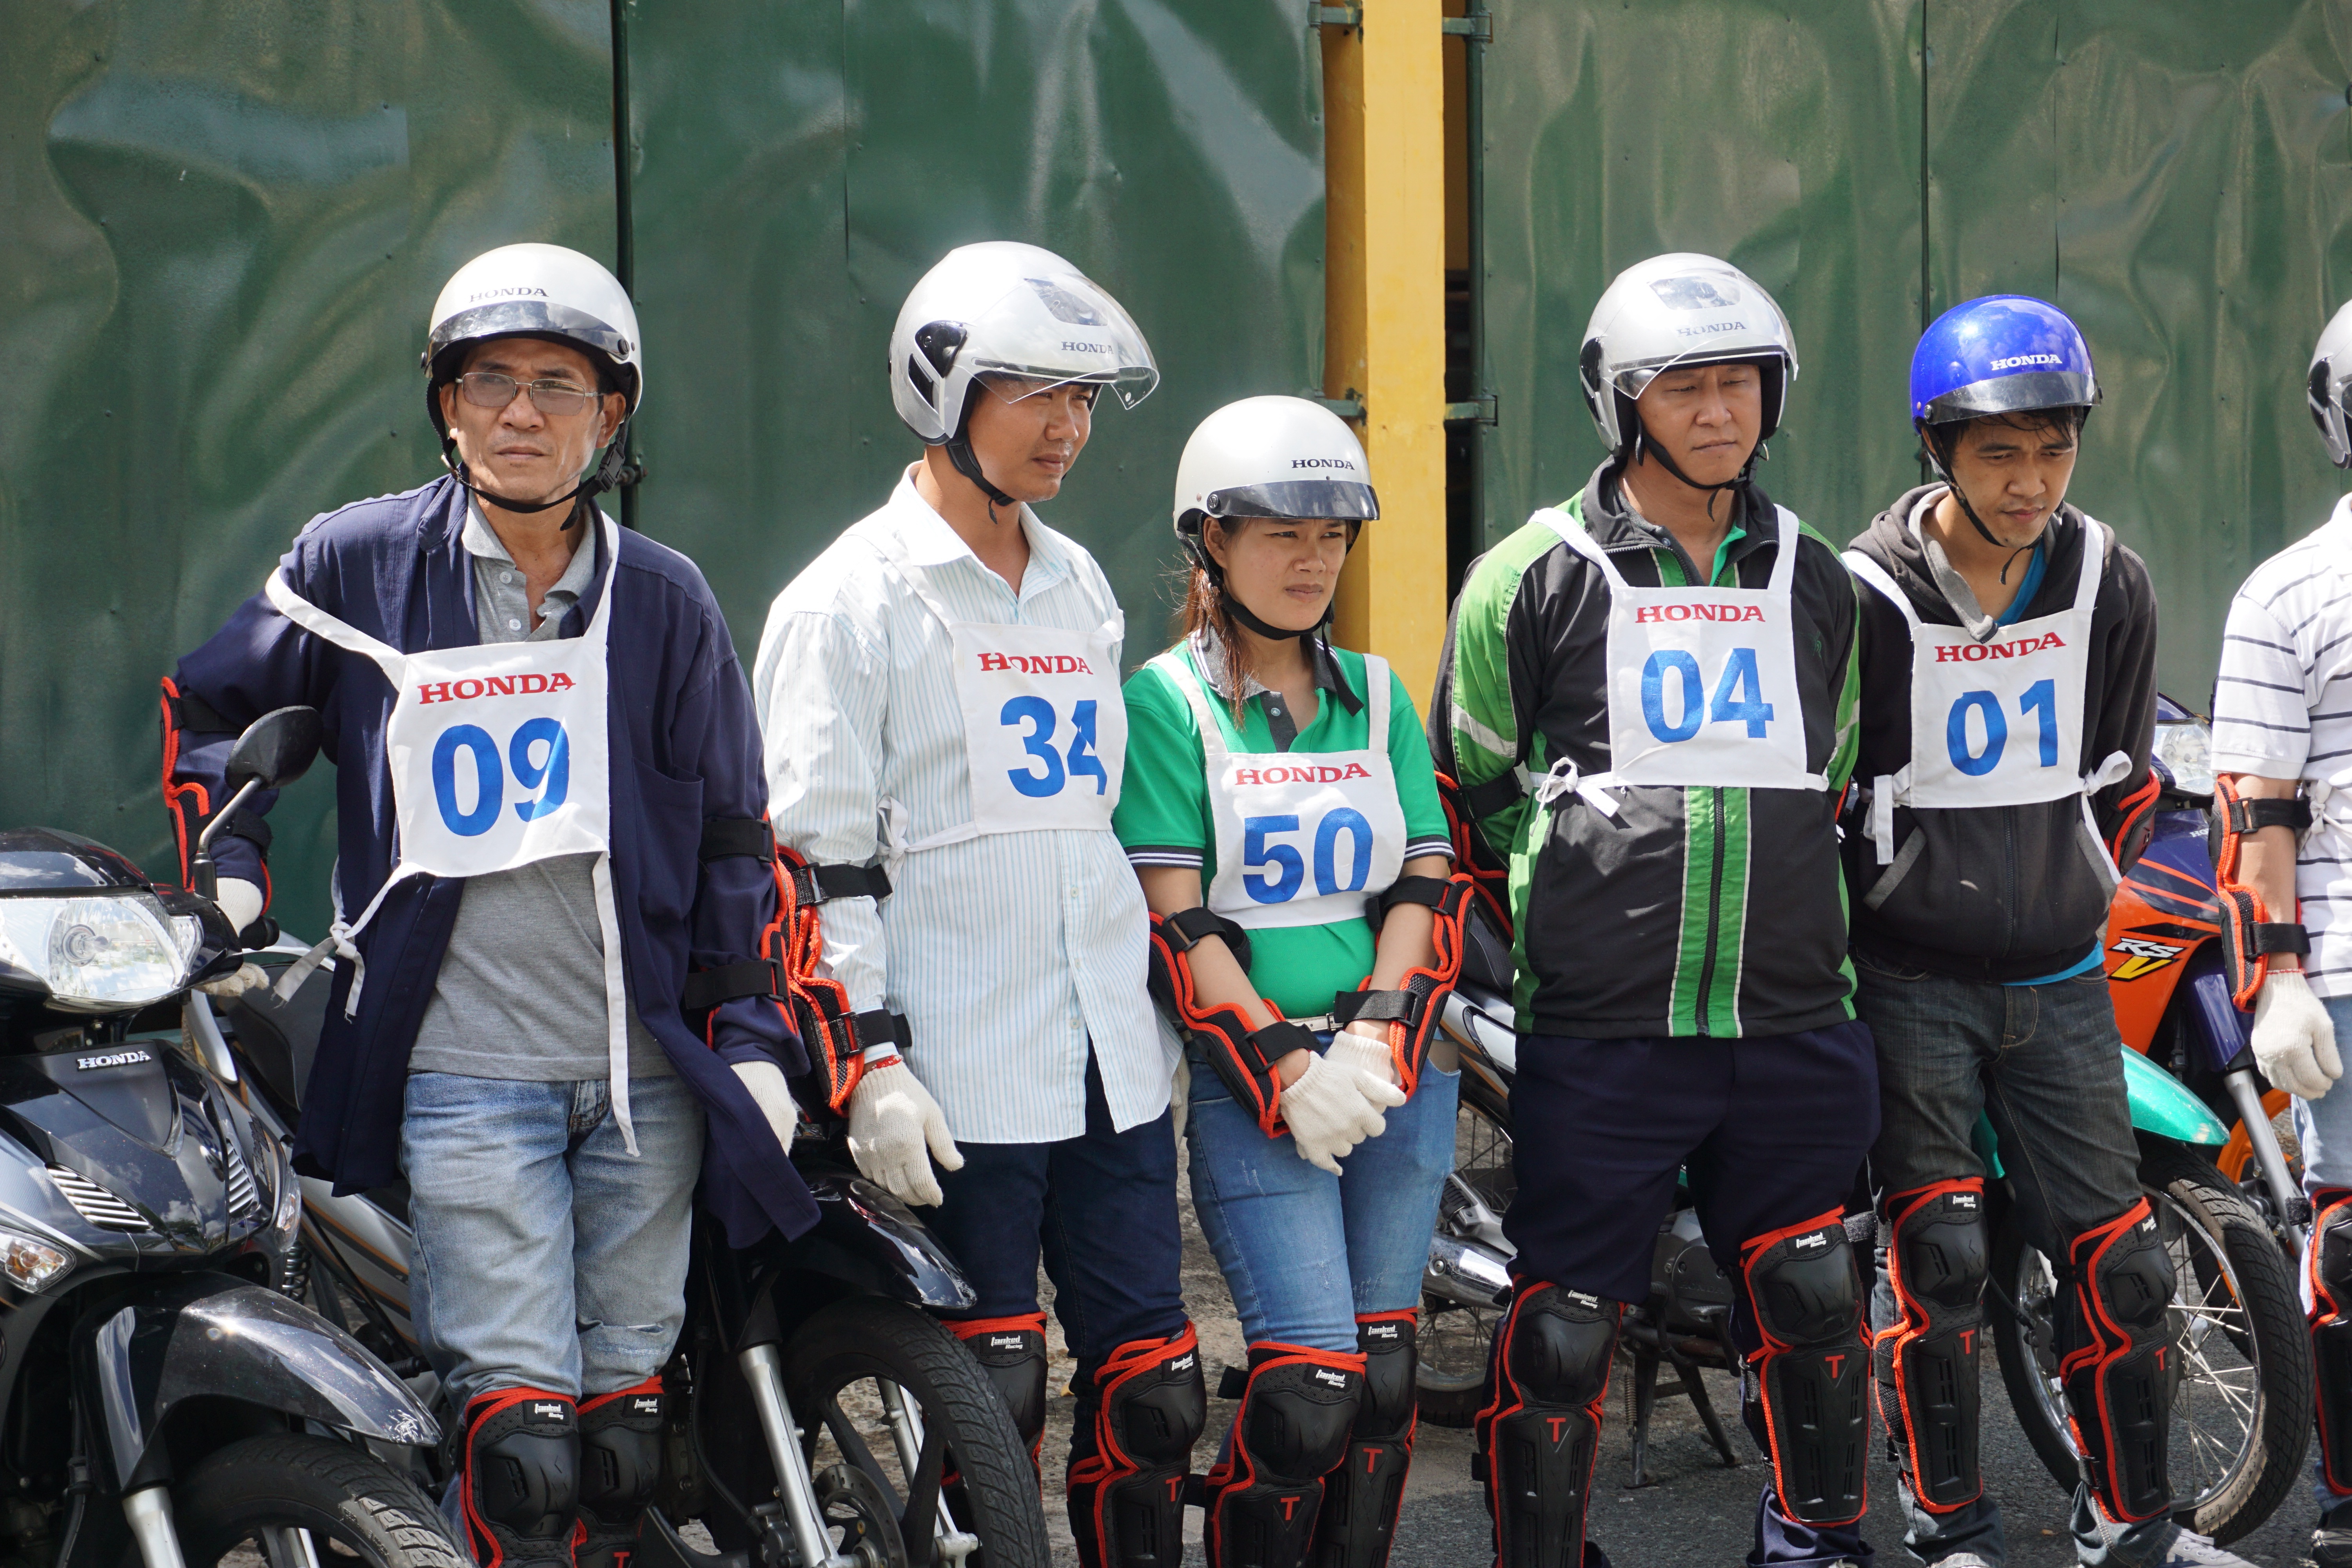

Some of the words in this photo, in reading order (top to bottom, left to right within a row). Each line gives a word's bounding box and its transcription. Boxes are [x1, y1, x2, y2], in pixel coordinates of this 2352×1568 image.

[469, 287, 549, 303] HONDA
[1677, 321, 1747, 337] HONDA
[1061, 341, 1114, 354] HONDA
[1990, 354, 2063, 367] HONDA
[1291, 459, 1355, 470] HONDA
[1636, 604, 1765, 623] HONDA
[1935, 632, 2066, 662] HONDA
[978, 653, 1093, 675] HONDA
[418, 673, 576, 704] HONDA
[1641, 648, 1774, 743] 04
[1947, 679, 2058, 776] 01
[1000, 696, 1107, 798] 34
[432, 717, 570, 837] 09
[1235, 763, 1371, 785] HONDA
[1243, 807, 1373, 904] 50
[2111, 937, 2185, 958] RS
[2111, 955, 2172, 979] V
[77, 1051, 152, 1069] HONDA
[1959, 1329, 1975, 1355] T
[1825, 1354, 1845, 1379] T
[2154, 1346, 2167, 1371] T
[1546, 1417, 1567, 1443] T
[1363, 1447, 1383, 1474] T
[1165, 1475, 1182, 1502] T
[1280, 1496, 1300, 1520] T
[613, 1552, 630, 1568] T
